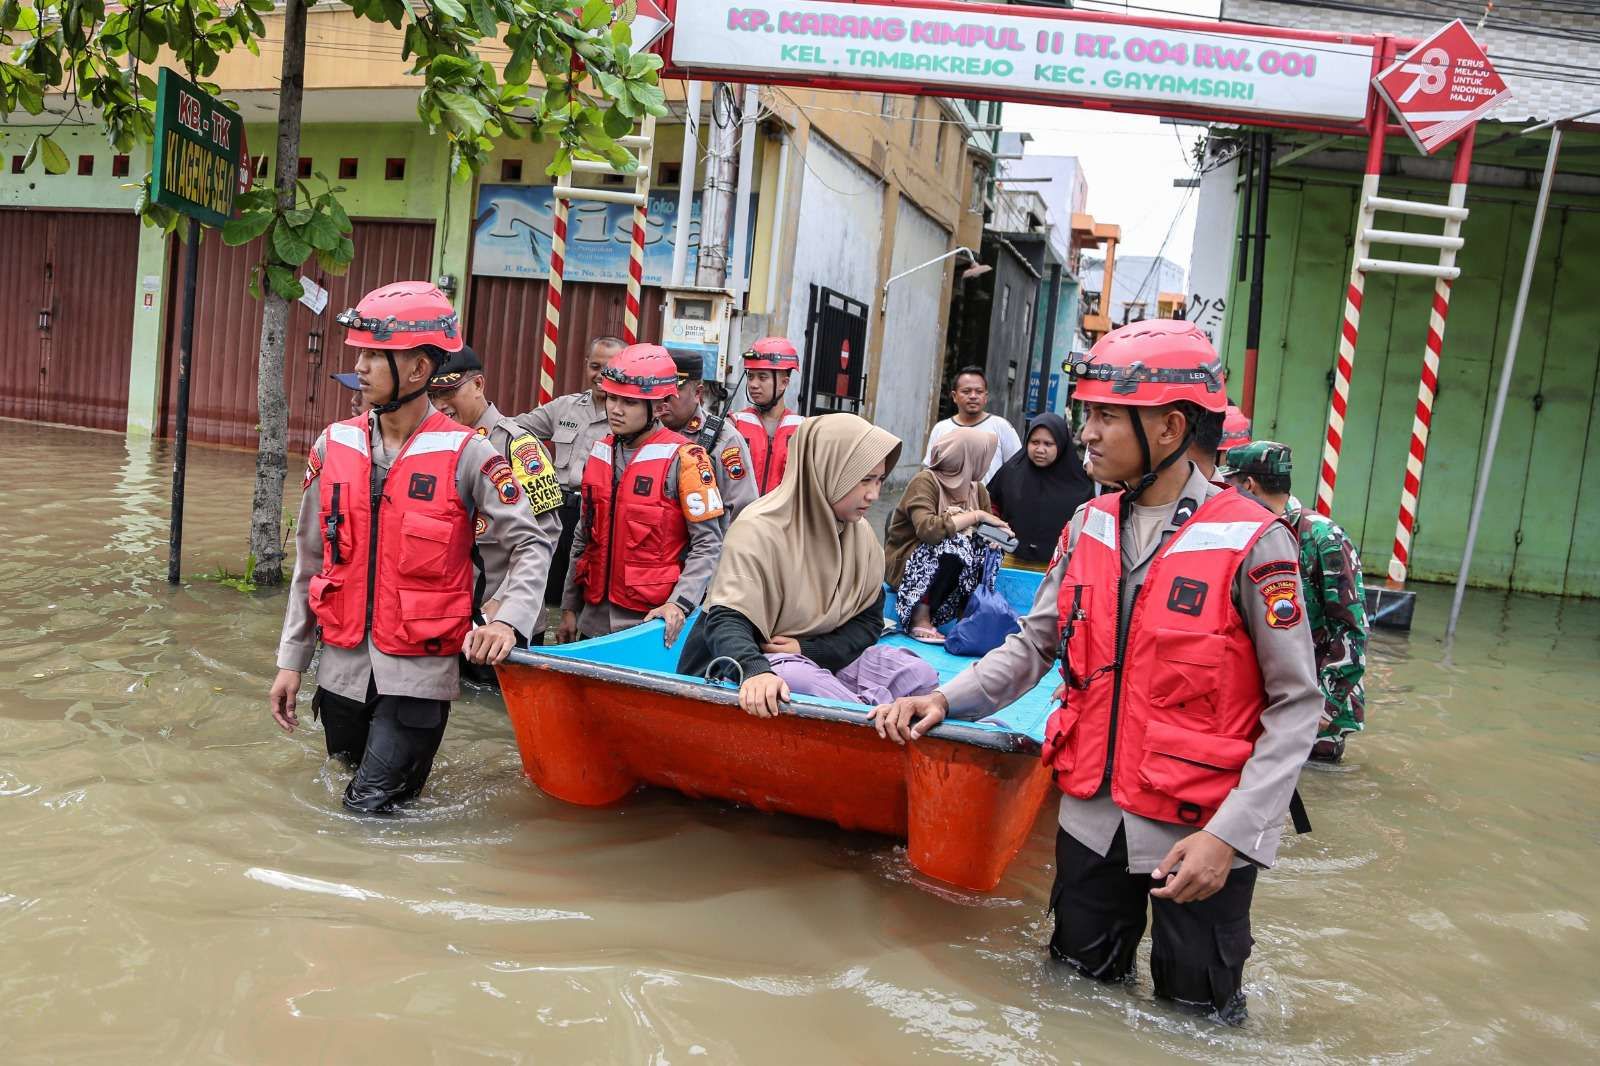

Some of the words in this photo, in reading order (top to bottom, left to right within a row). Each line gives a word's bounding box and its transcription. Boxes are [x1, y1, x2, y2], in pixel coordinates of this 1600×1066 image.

[727, 8, 775, 33] KP.
[777, 11, 905, 41] KARANG
[911, 20, 1025, 51] KIMPUL
[1075, 32, 1120, 59] RT.
[1124, 38, 1188, 65] 004
[1193, 44, 1252, 72] RW.
[1258, 50, 1316, 77] 001
[846, 48, 1014, 77] TAMBAKREJO
[1103, 70, 1254, 100] GAYAMSARI
[1398, 48, 1449, 103] 78
[1454, 68, 1490, 78] MELAJU
[1456, 58, 1484, 68] TERUS
[1451, 85, 1498, 96] INDONESIA
[1453, 77, 1483, 86] UNTUK
[1450, 94, 1475, 103] MAJU
[211, 110, 231, 150] TK
[165, 130, 179, 192] KI
[178, 138, 213, 208] AGENG
[212, 155, 235, 217] SELO
[476, 198, 701, 252] Nis
[1189, 372, 1206, 380] LED
